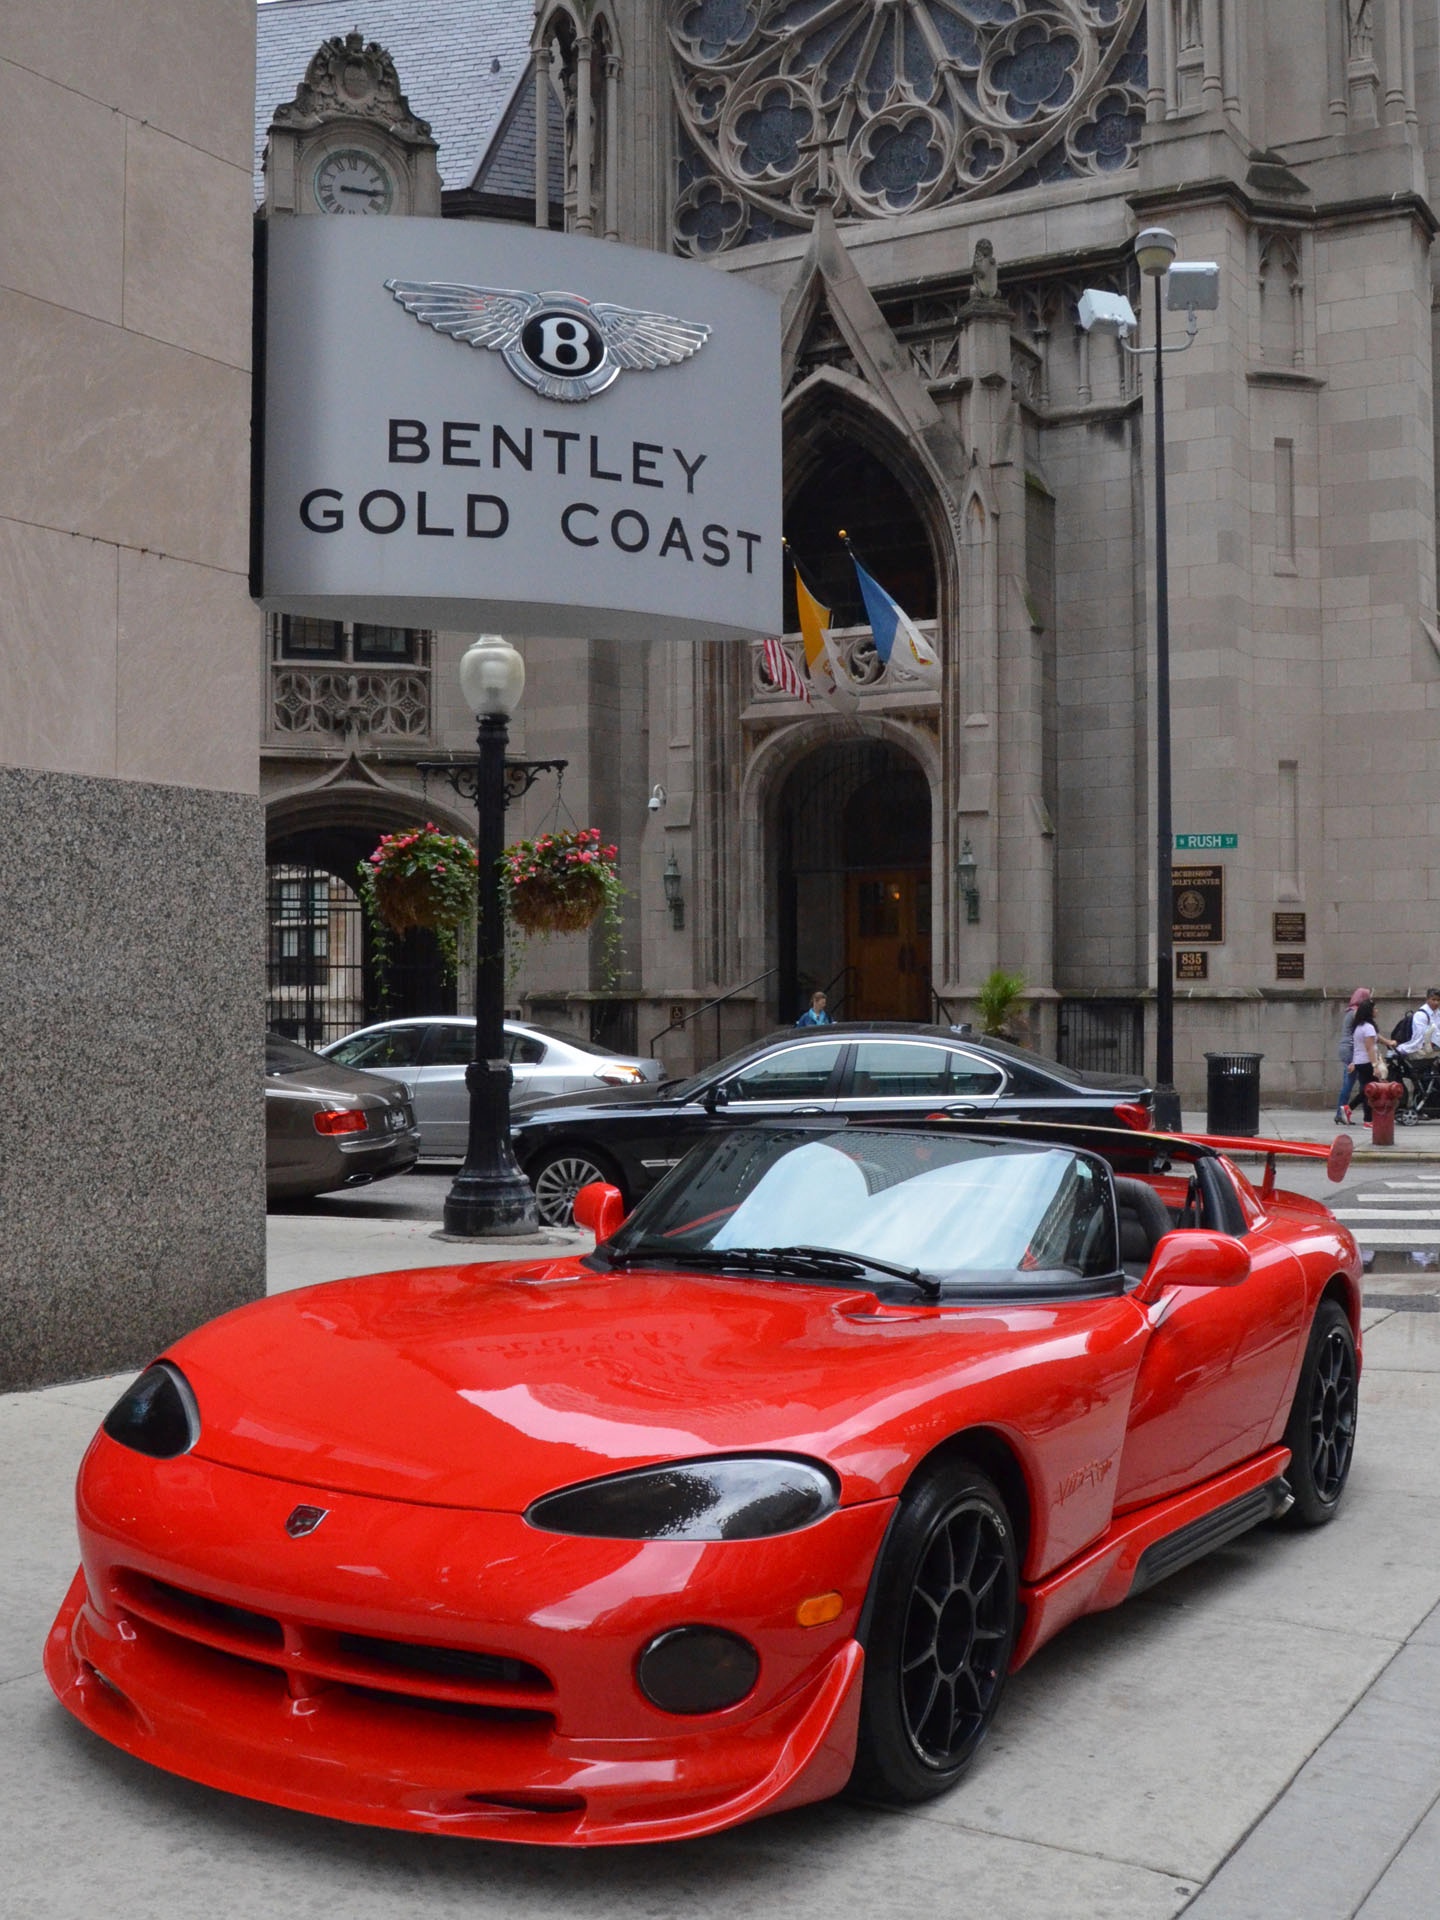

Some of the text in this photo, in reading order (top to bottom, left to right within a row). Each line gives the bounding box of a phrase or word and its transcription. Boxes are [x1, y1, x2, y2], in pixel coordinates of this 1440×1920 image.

[539, 316, 590, 370] B
[388, 418, 708, 494] BENTLEY
[299, 489, 762, 574] GOLD COAST
[1179, 835, 1234, 848] N RUSH ST
[1182, 953, 1202, 965] 835
